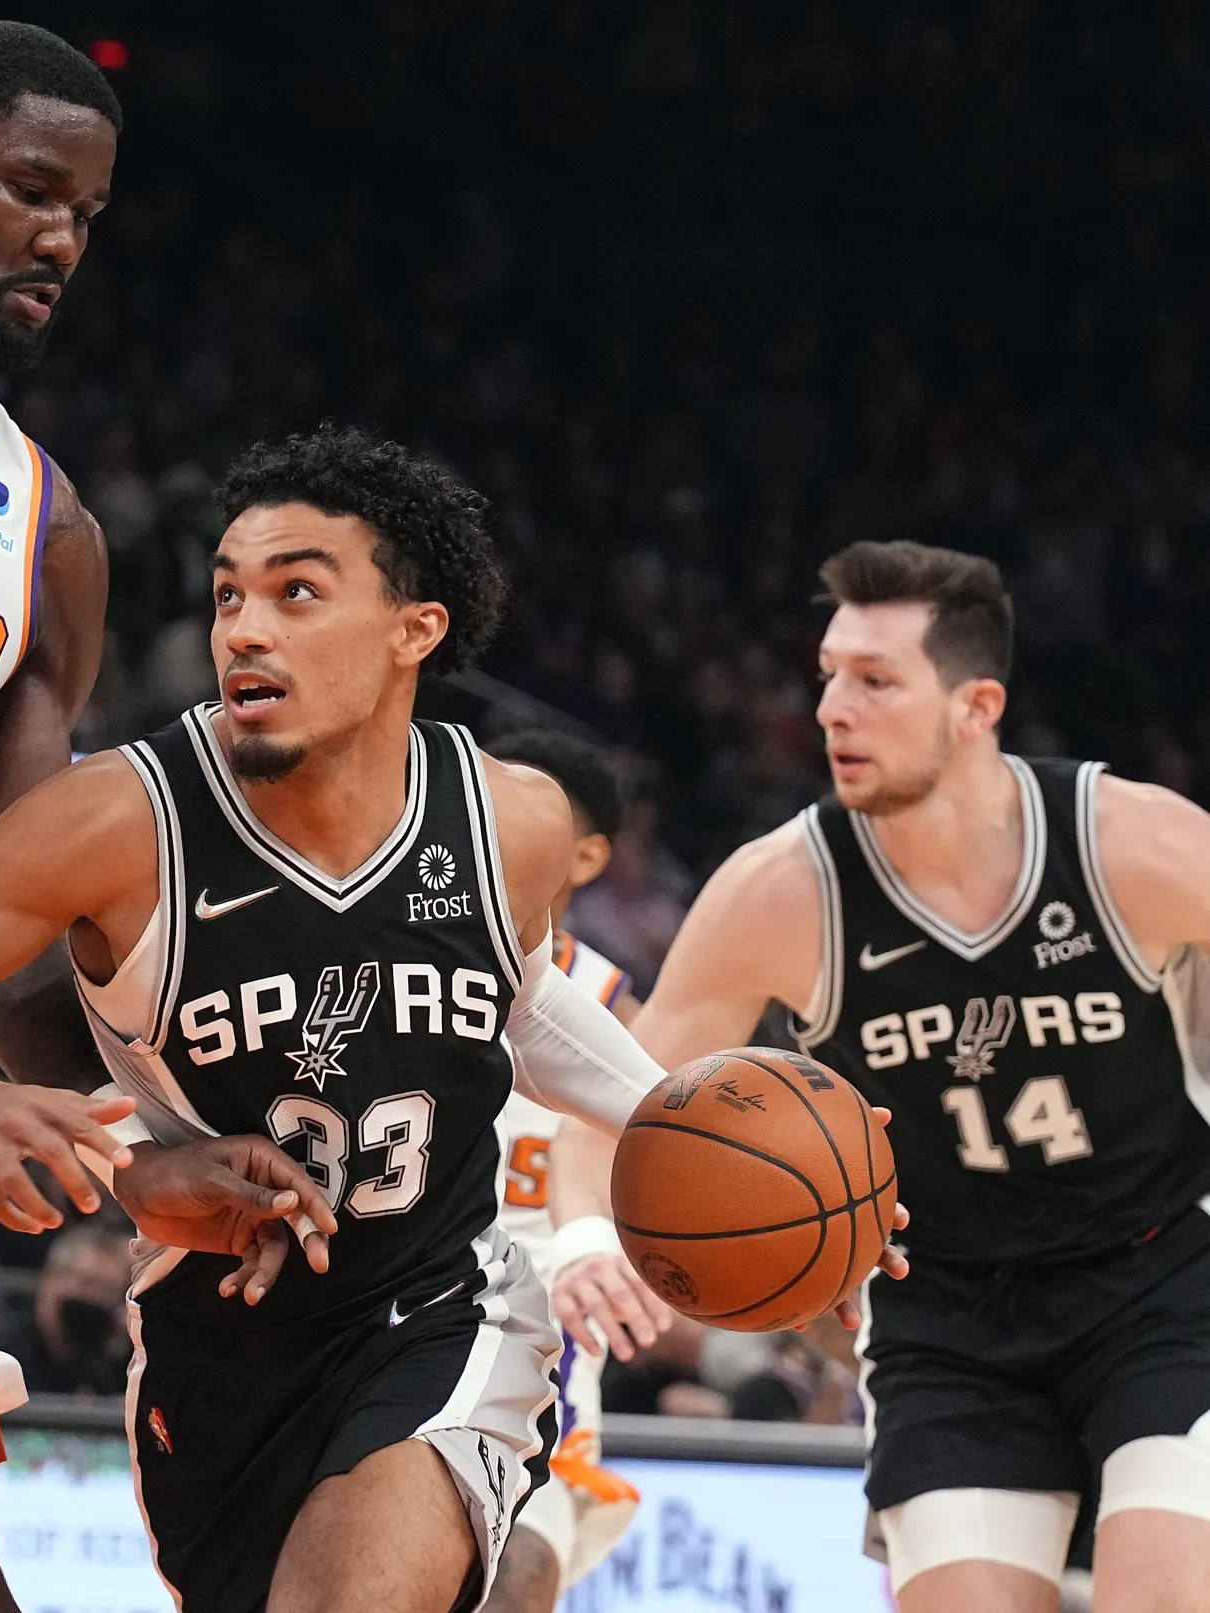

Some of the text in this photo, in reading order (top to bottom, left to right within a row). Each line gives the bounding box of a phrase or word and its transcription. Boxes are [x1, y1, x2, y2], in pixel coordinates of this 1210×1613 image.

[406, 889, 473, 923] Frost
[1033, 931, 1097, 970] Frost
[179, 962, 499, 1091] SPURS
[860, 991, 1126, 1080] SPURS
[265, 1090, 436, 1219] 33
[940, 1074, 1093, 1173] 14
